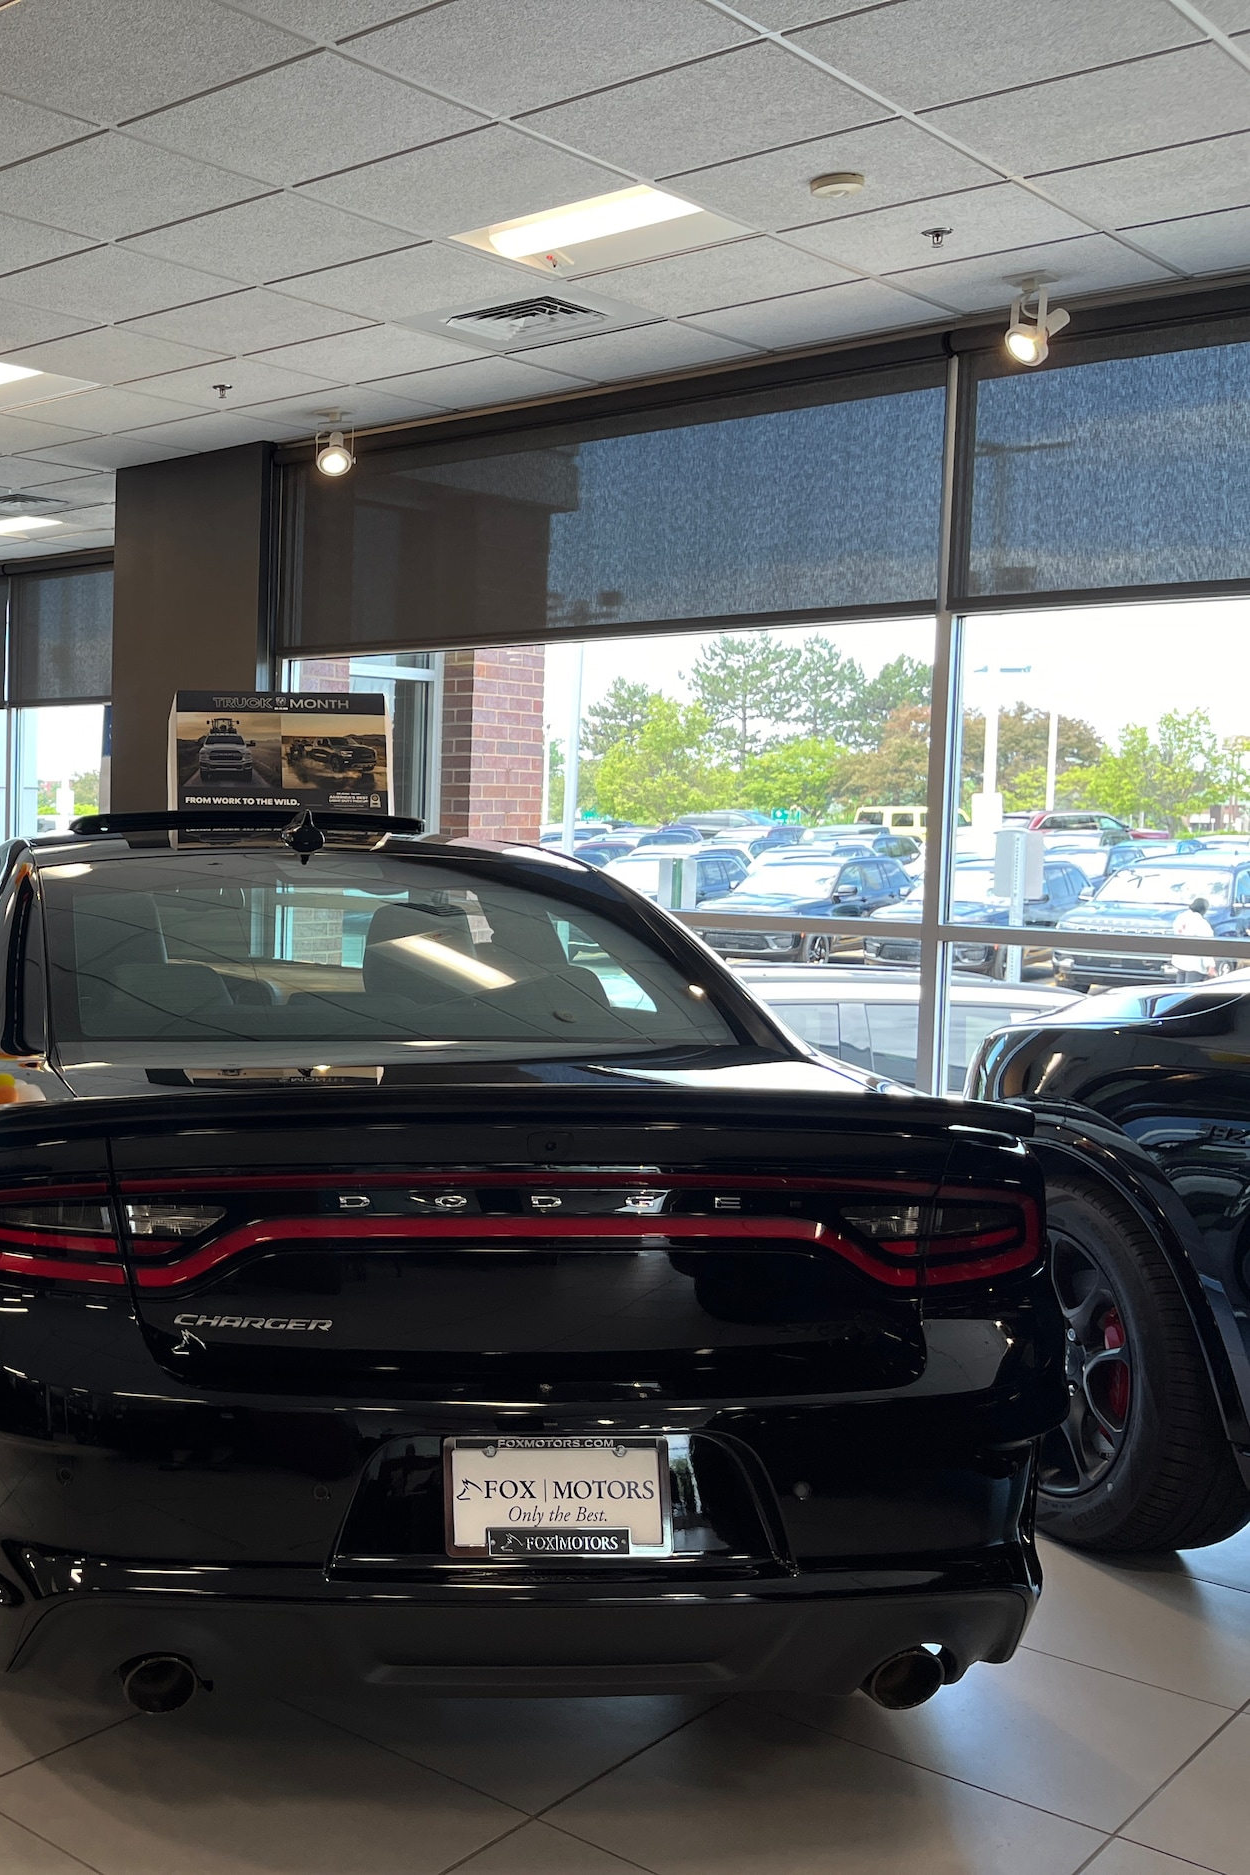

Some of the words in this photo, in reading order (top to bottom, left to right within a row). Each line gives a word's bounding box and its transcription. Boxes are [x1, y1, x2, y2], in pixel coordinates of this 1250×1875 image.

[212, 697, 273, 709] TRUCK
[289, 698, 349, 711] MONTH
[185, 797, 212, 805] FROM
[212, 797, 241, 805] WORK
[339, 1194, 741, 1210] DODGE
[173, 1312, 334, 1332] CHARGER
[497, 1439, 614, 1448] FOXMOTORS.COM
[483, 1480, 537, 1499] FOX
[553, 1480, 655, 1500] MOTORS
[508, 1505, 544, 1527] Only
[549, 1506, 572, 1522] the
[576, 1506, 608, 1522] Best.
